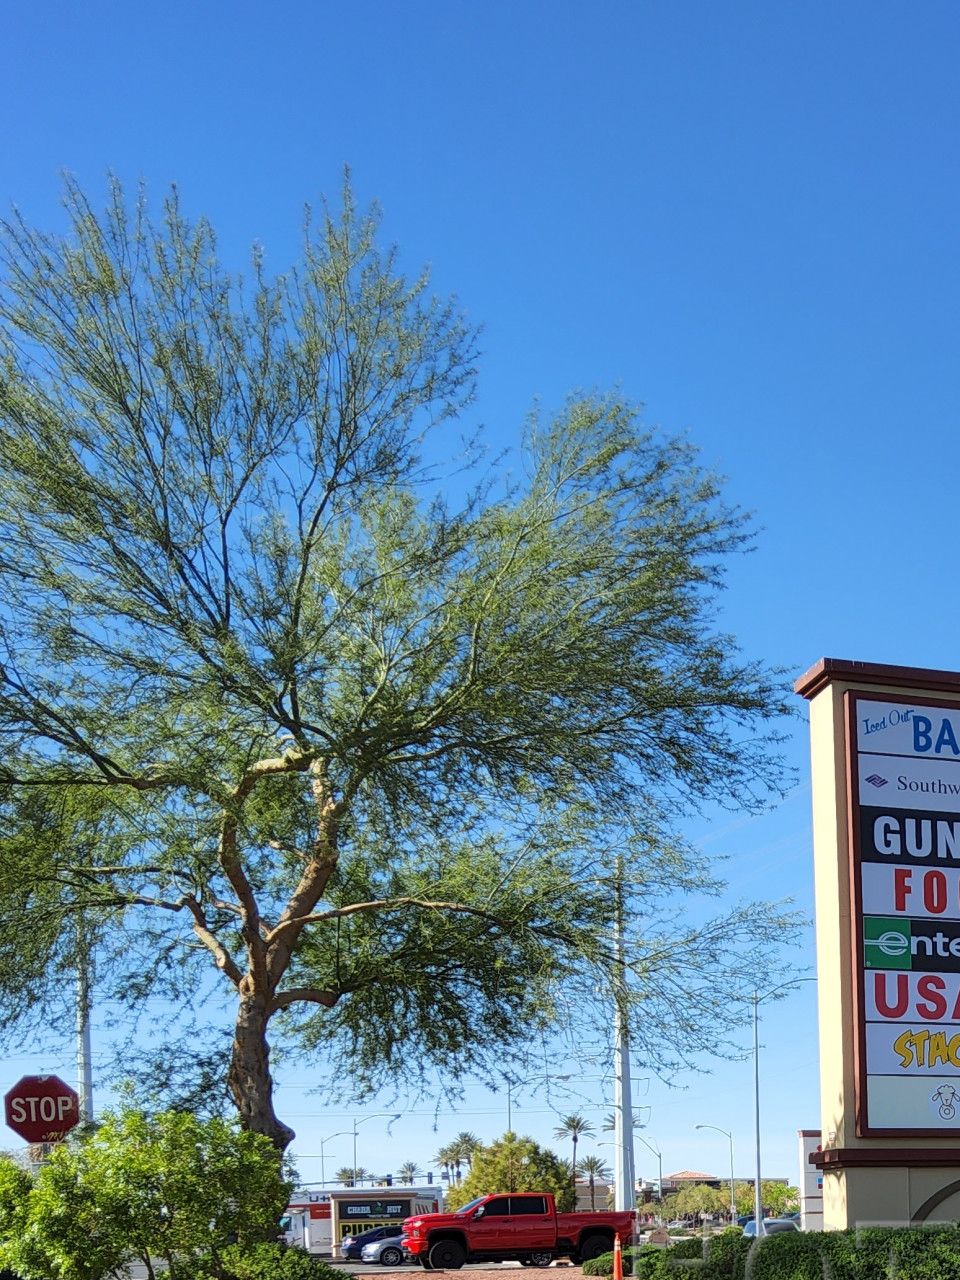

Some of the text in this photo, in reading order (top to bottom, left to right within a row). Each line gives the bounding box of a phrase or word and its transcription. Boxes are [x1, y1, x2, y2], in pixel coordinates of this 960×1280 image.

[863, 709, 914, 735] Iced Out
[11, 1096, 73, 1123] STOP
